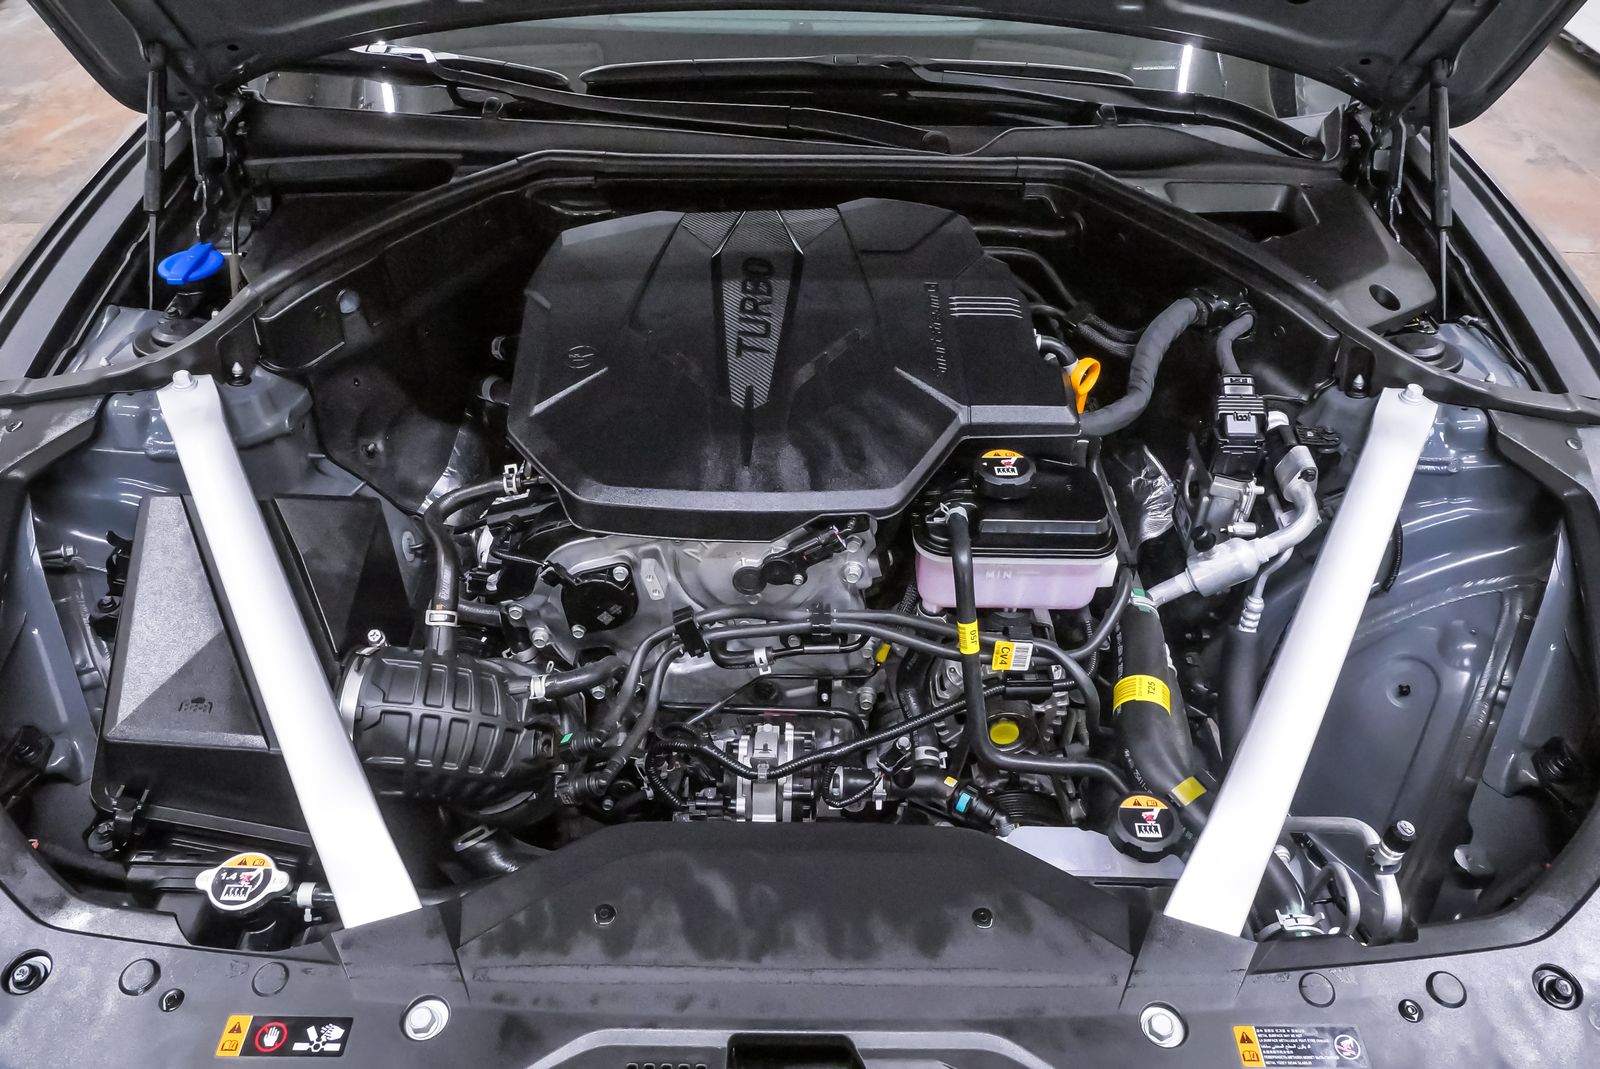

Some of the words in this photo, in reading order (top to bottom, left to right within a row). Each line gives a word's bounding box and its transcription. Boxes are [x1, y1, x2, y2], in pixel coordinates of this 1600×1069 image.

[735, 256, 775, 359] TURBO
[985, 570, 1013, 580] MIN
[998, 646, 1011, 666] CV4
[1147, 681, 1156, 695] T25
[220, 871, 238, 881] 1.4
